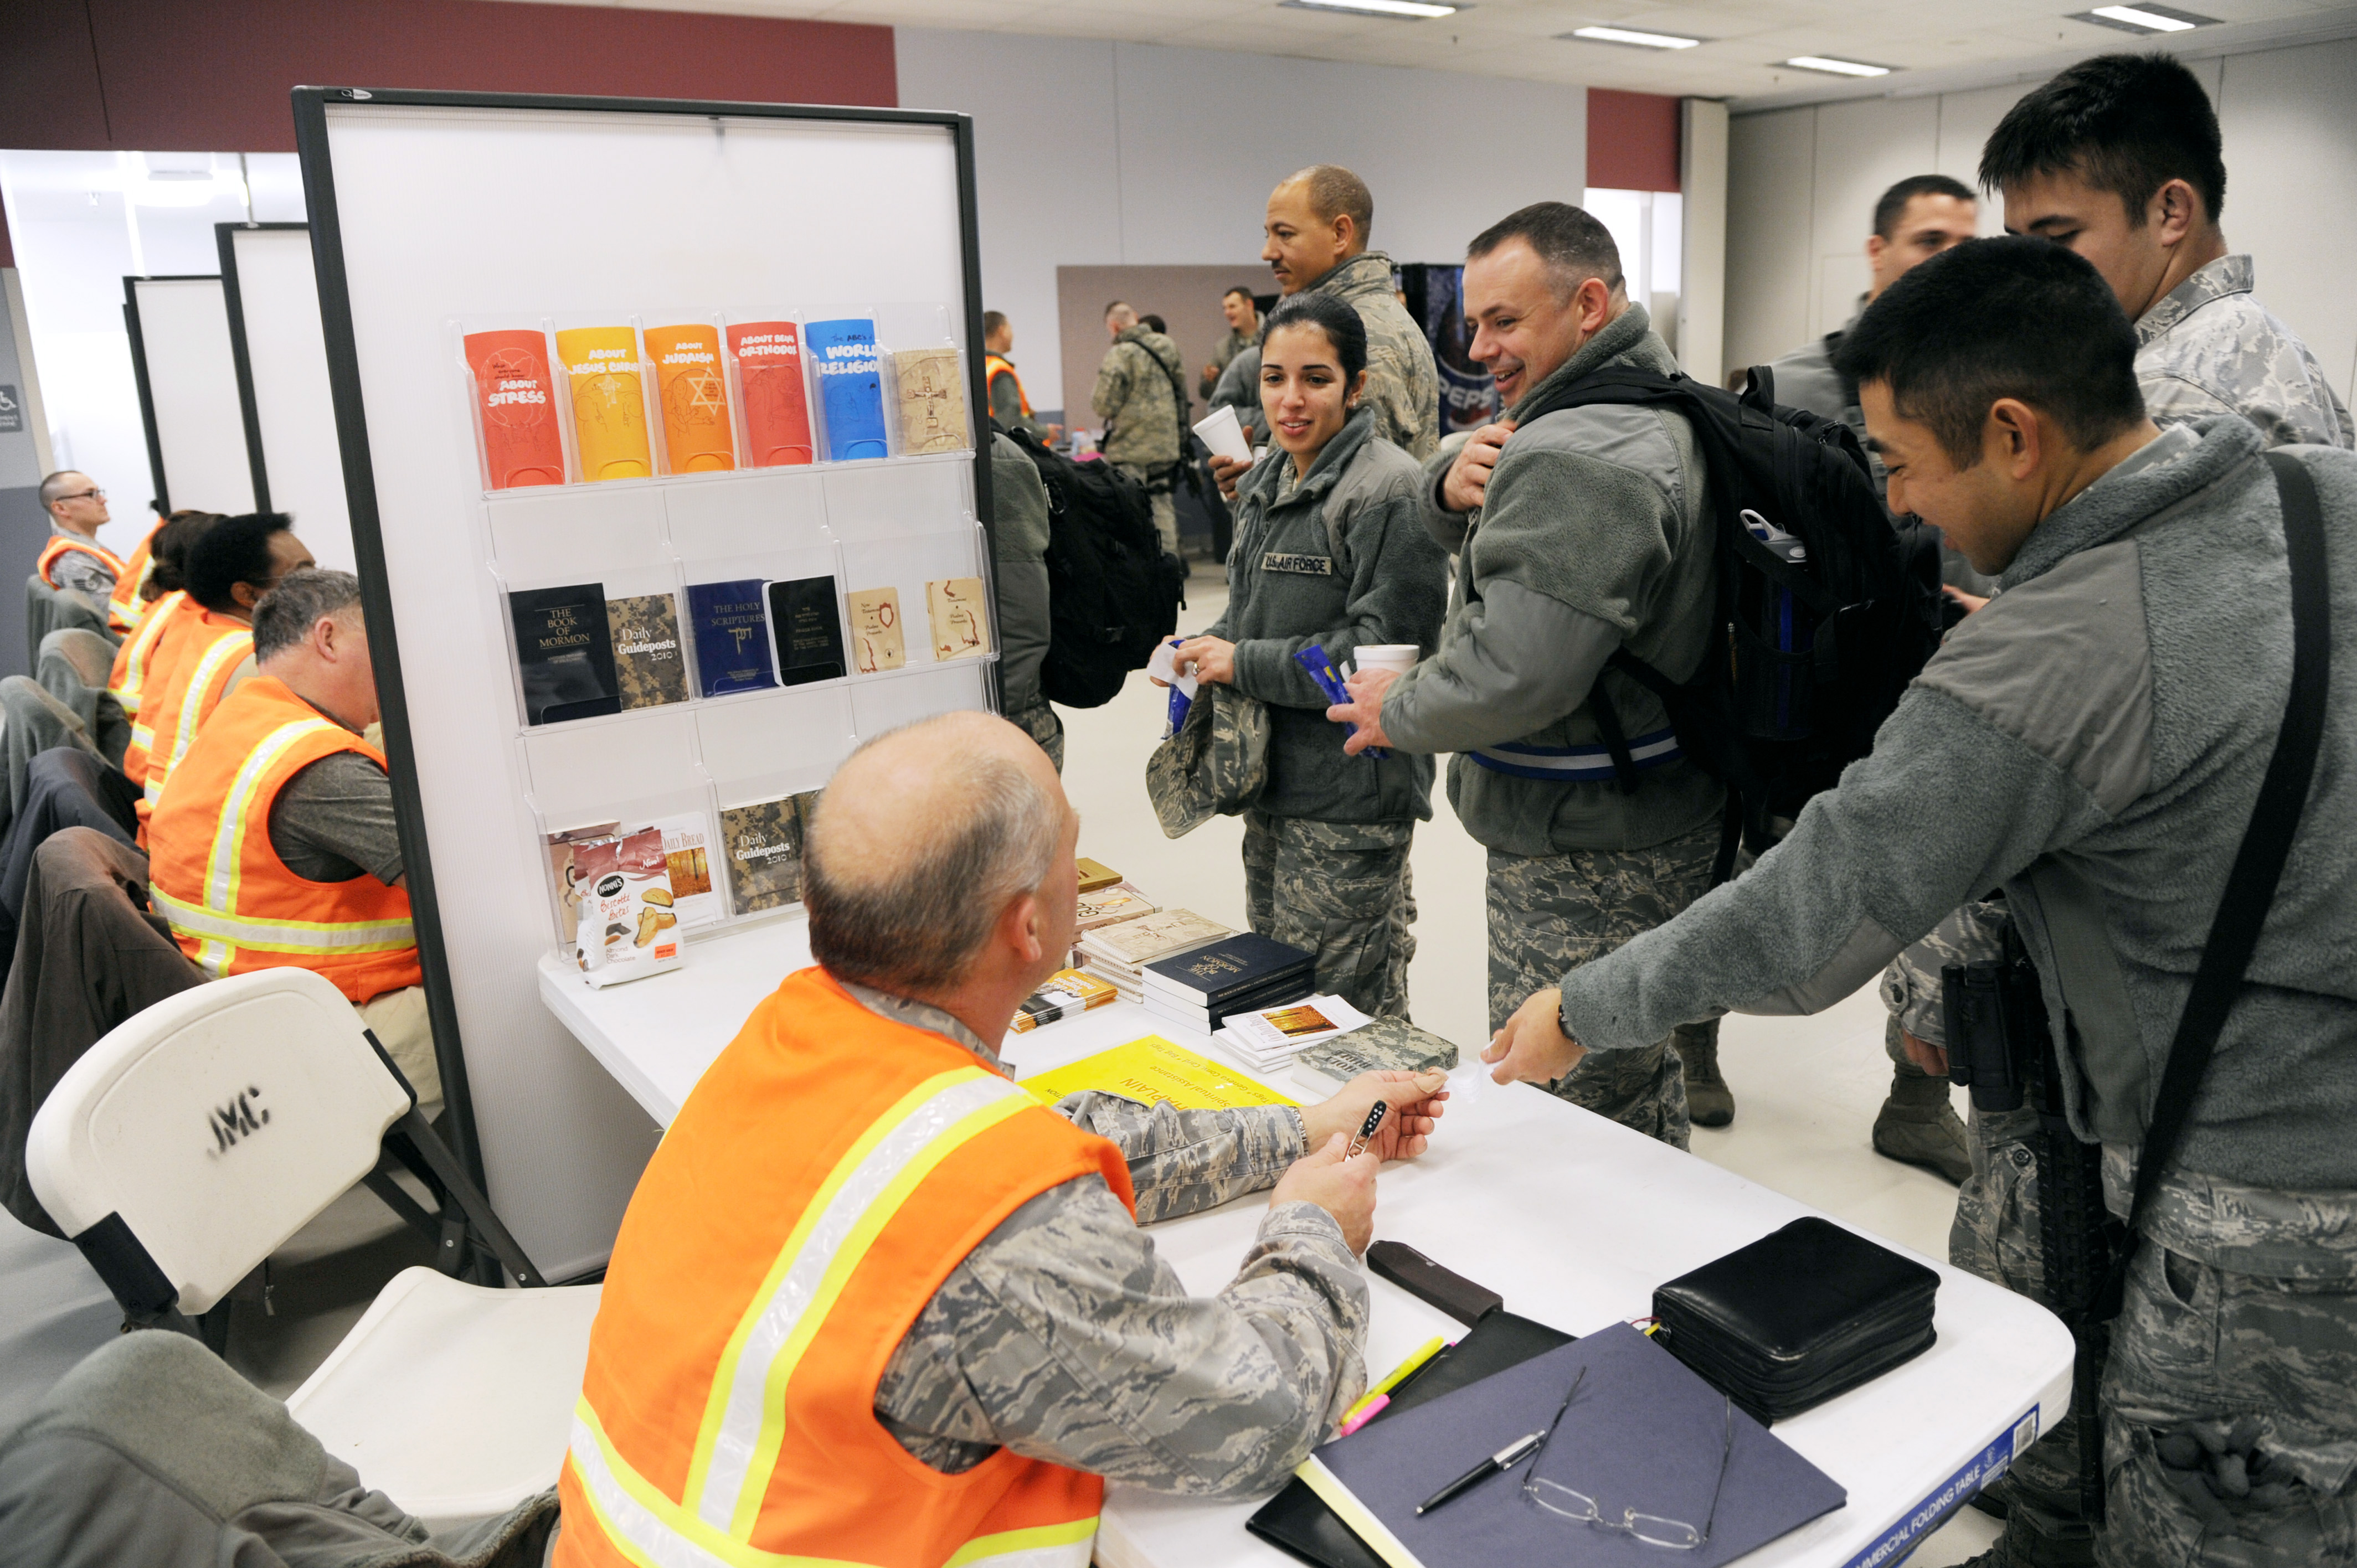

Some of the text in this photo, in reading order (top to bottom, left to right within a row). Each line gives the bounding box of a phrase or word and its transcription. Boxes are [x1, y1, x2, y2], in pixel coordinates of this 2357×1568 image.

[741, 334, 773, 345] ABOUT
[589, 349, 626, 360] ABOUT
[739, 344, 797, 357] ORTHODOX
[662, 352, 714, 364] JUDAISM
[568, 362, 639, 375] JESUS CHRIS
[500, 380, 537, 391] ABOUT
[1439, 375, 1494, 410] PEPS
[488, 390, 546, 407] STRESS
[1278, 556, 1292, 569] AIR
[1293, 557, 1326, 571] FORCE
[550, 608, 572, 618] THE
[713, 602, 760, 614] THE HOLY
[547, 617, 577, 628] BOOK
[711, 613, 765, 626] SCRIPTURES
[556, 627, 570, 636] OF
[622, 626, 652, 642] Daily
[539, 633, 589, 647] MORMON
[618, 639, 676, 654] Guideposts
[651, 652, 673, 661] 2010
[681, 833, 704, 847] BREAD
[740, 832, 768, 847] Daily
[737, 842, 790, 861] Guideposts
[640, 856, 660, 870] New!
[766, 854, 787, 864] 2010
[599, 878, 623, 895] NONNI'S
[600, 893, 630, 912] Biscotti
[609, 906, 629, 921] Bites
[607, 956, 636, 964] Chocolate
[1200, 955, 1241, 973] MORMON
[1188, 967, 1206, 976] THE
[1192, 963, 1218, 974] BOOK
[1150, 1043, 1165, 1053] Tags
[1164, 1050, 1179, 1058] Bag
[1182, 1059, 1201, 1068] Card
[1329, 1056, 1358, 1072] HOLY
[1331, 1049, 1372, 1069] BIBLE
[1150, 1066, 1231, 1107] Spiritual Assistance
[1221, 1075, 1248, 1091] Geneva
[1119, 1078, 1189, 1111] HAPLAIN
[1252, 1092, 1270, 1103] Tags
[207, 1086, 269, 1160] JMC
[1911, 1487, 1955, 1534] FOLDING
[1955, 1464, 1981, 1495] TABLE
